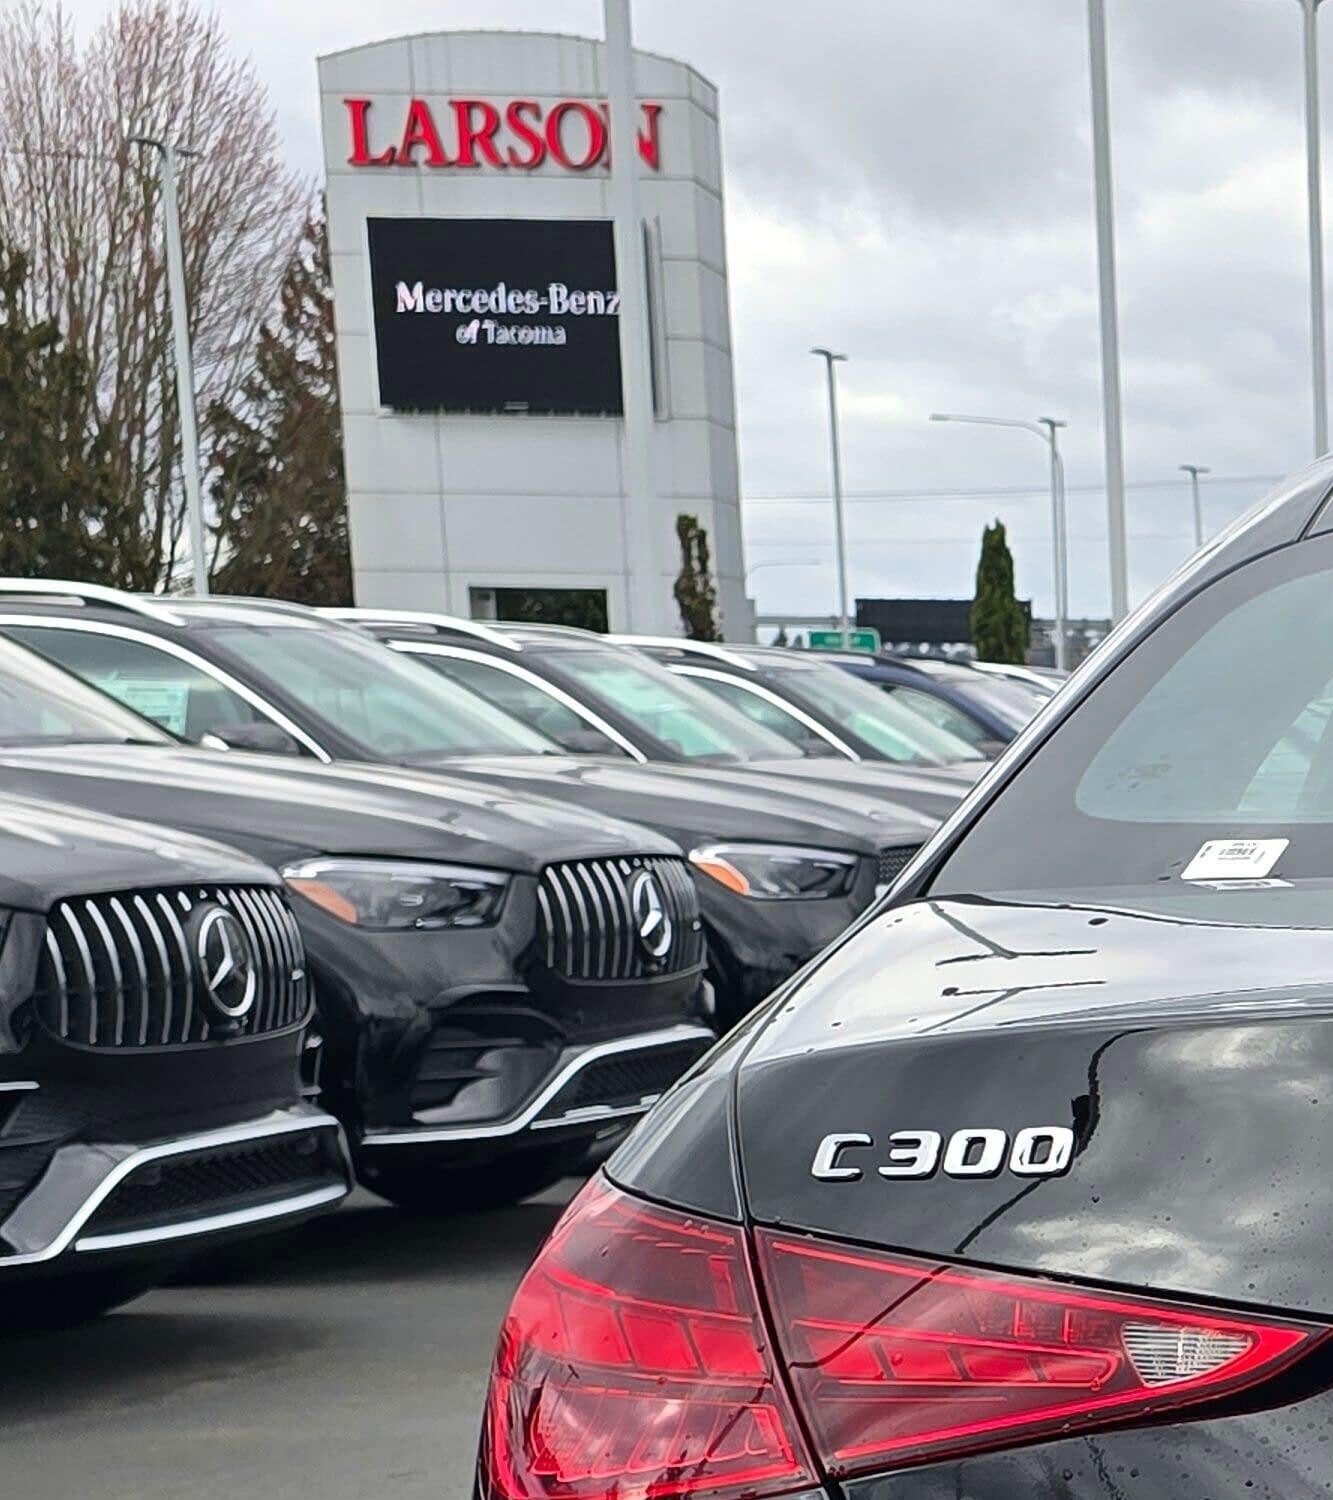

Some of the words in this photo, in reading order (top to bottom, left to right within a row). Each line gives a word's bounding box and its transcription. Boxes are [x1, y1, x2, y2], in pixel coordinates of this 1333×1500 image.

[395, 281, 621, 315] Mercedes-Benz
[456, 319, 480, 344] of
[482, 320, 566, 345] Tacoma
[811, 1132, 872, 1180] C
[877, 1126, 1076, 1179] 300
